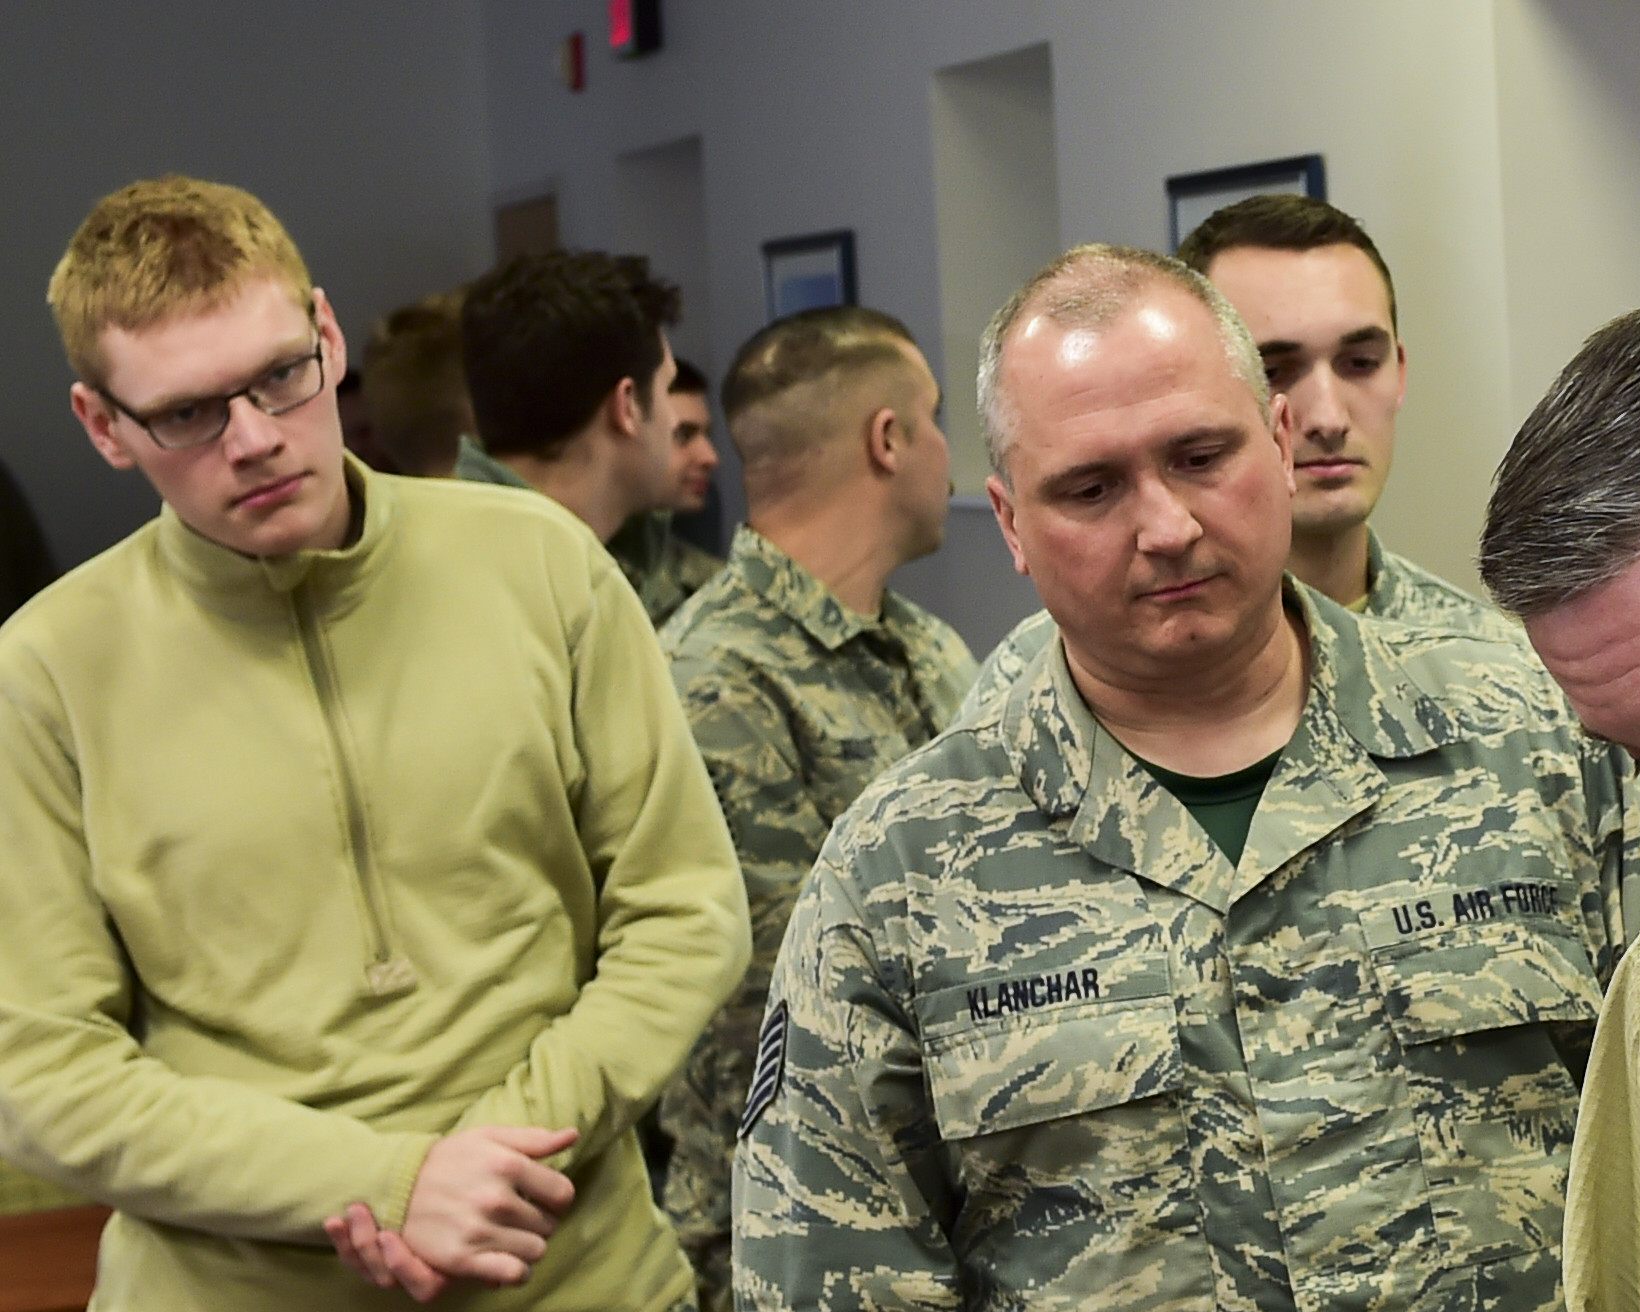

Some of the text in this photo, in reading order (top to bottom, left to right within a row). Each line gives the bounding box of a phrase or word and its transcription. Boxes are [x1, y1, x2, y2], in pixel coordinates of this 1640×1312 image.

[1392, 882, 1558, 935] U.S. AIR FORCE
[967, 968, 1100, 1021] KLANCHAR
